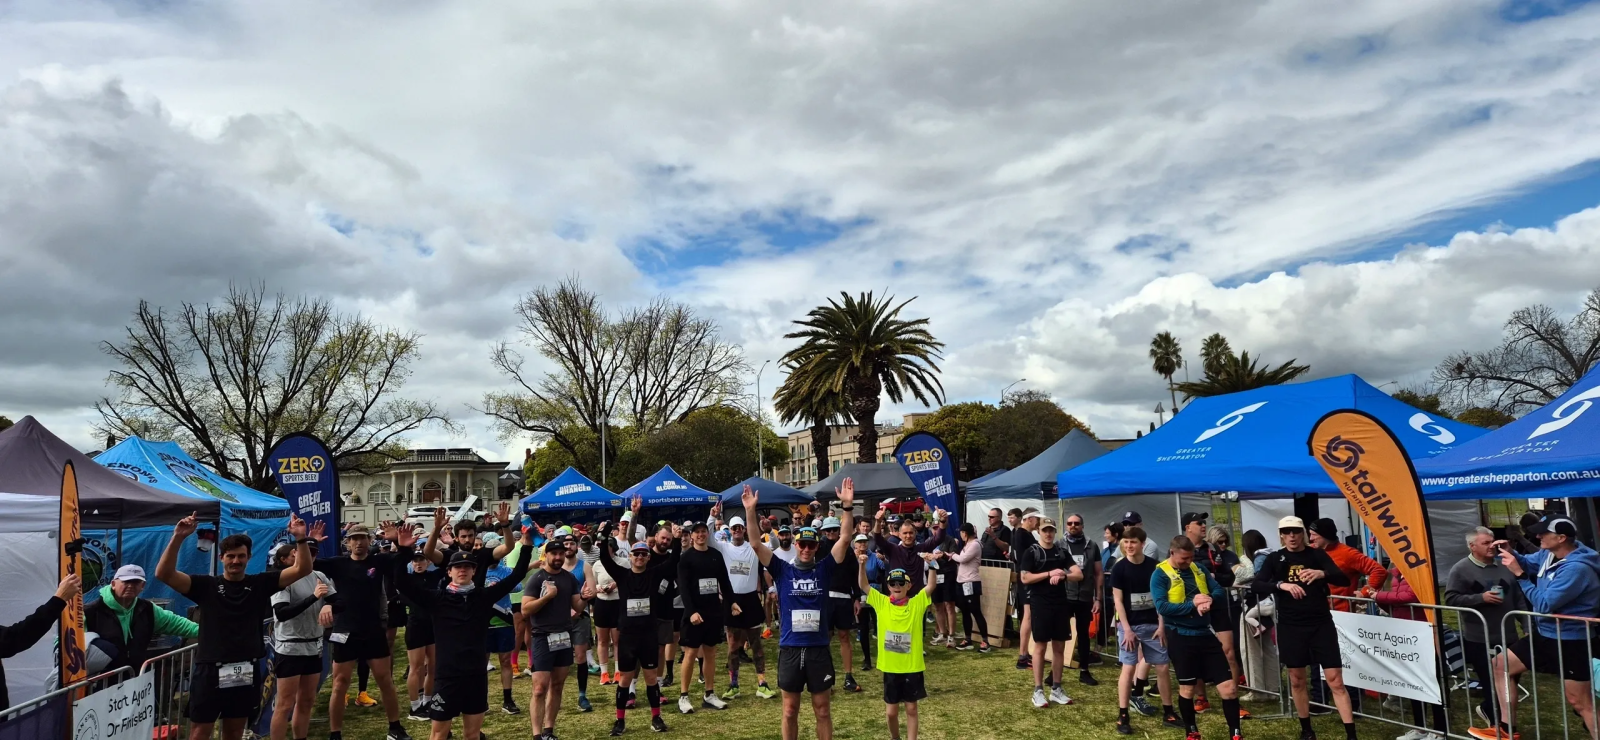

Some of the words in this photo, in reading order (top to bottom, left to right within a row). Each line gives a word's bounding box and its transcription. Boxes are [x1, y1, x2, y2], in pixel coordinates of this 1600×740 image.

[1176, 446, 1212, 454] GREATER
[1501, 440, 1560, 453] GREATER
[1156, 453, 1207, 462] SHEPPARTON
[285, 474, 303, 482] SPORTS
[304, 473, 317, 481] BEER
[924, 475, 943, 492] GREAT
[1421, 469, 1600, 487] www.greatershepparton.com.au
[555, 485, 592, 496] ENHANCED
[937, 483, 952, 497] BEER
[298, 490, 322, 509] GREAT
[1343, 481, 1370, 517] NUTRITION
[312, 501, 331, 517] BEER
[1351, 469, 1428, 569] tailwind
[1357, 628, 1381, 641] Start
[1384, 632, 1419, 647] Again?
[1358, 643, 1371, 654] Or
[1373, 646, 1420, 663] Finished?
[233, 666, 242, 674] 59
[1358, 673, 1368, 681] Go
[1381, 676, 1394, 686] just
[108, 695, 129, 713] Start
[107, 722, 121, 738] Or
